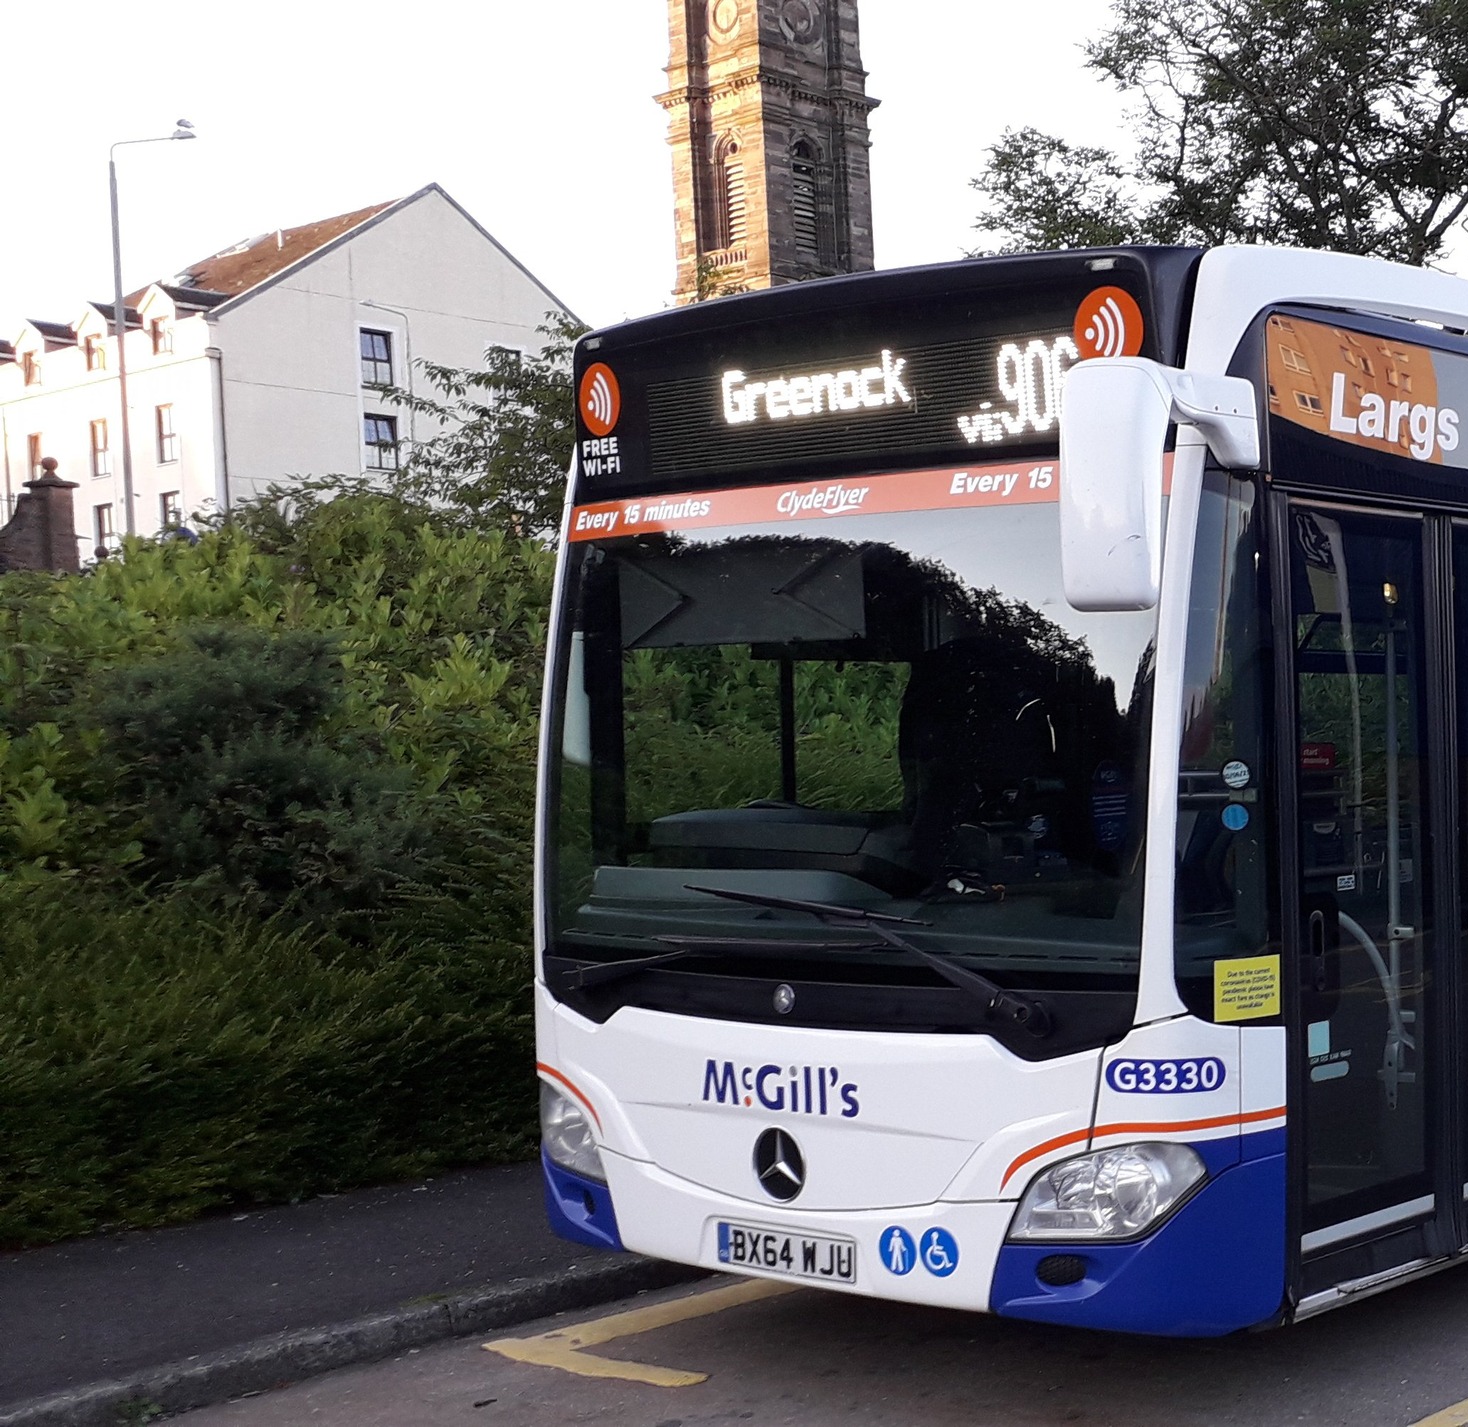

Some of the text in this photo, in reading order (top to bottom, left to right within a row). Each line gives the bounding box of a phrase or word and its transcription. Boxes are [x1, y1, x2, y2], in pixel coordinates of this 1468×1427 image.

[721, 349, 912, 424] Greenock
[1329, 372, 1460, 461] Largs
[582, 437, 618, 457] FREE
[583, 456, 621, 477] WI-FI
[950, 466, 1053, 496] Every 15
[575, 500, 711, 531] Every 15 minutes
[776, 484, 869, 516] ClydeFlyer
[703, 1058, 860, 1118] McGill's
[1110, 1057, 1220, 1092] G3330
[732, 1229, 851, 1278] BX64 WJU
